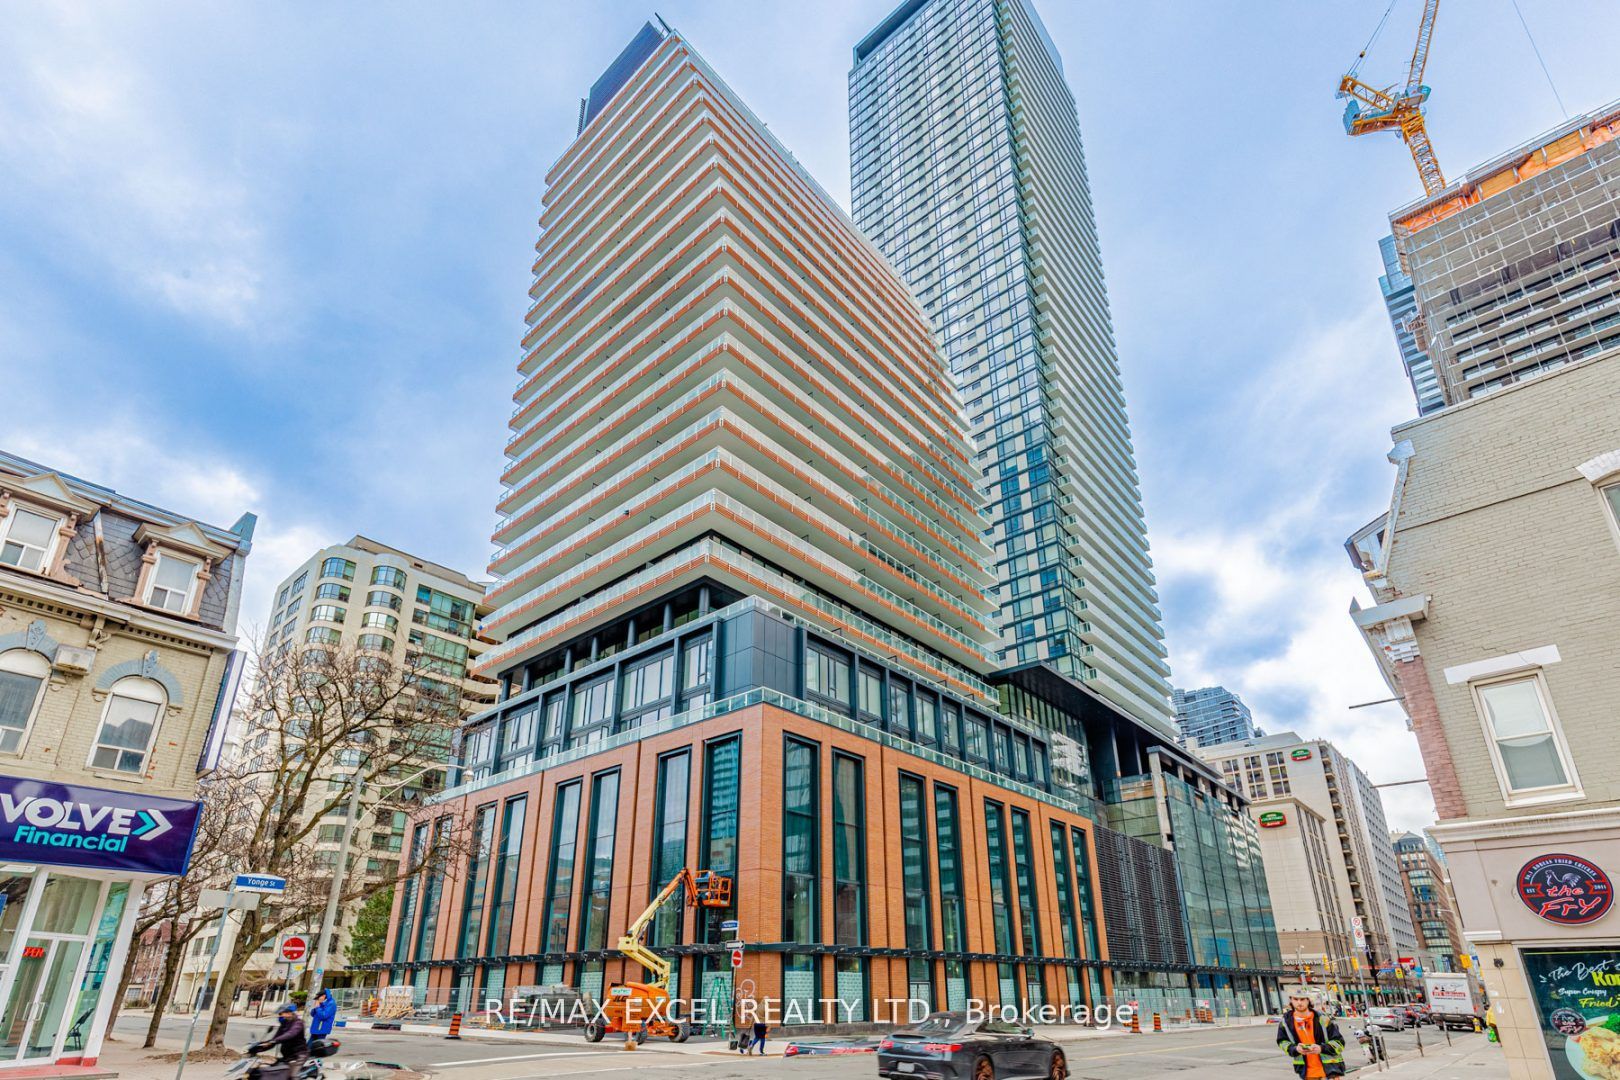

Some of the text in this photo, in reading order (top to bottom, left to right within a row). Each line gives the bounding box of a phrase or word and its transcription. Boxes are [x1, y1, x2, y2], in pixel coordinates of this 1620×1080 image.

[13, 825, 128, 853] Financial
[247, 877, 269, 887] Yonge
[1547, 885, 1584, 897] the
[1548, 966, 1573, 981] The
[1572, 959, 1615, 981] Best
[1558, 987, 1607, 997] Super Crispy
[1578, 996, 1619, 1008] Fried
